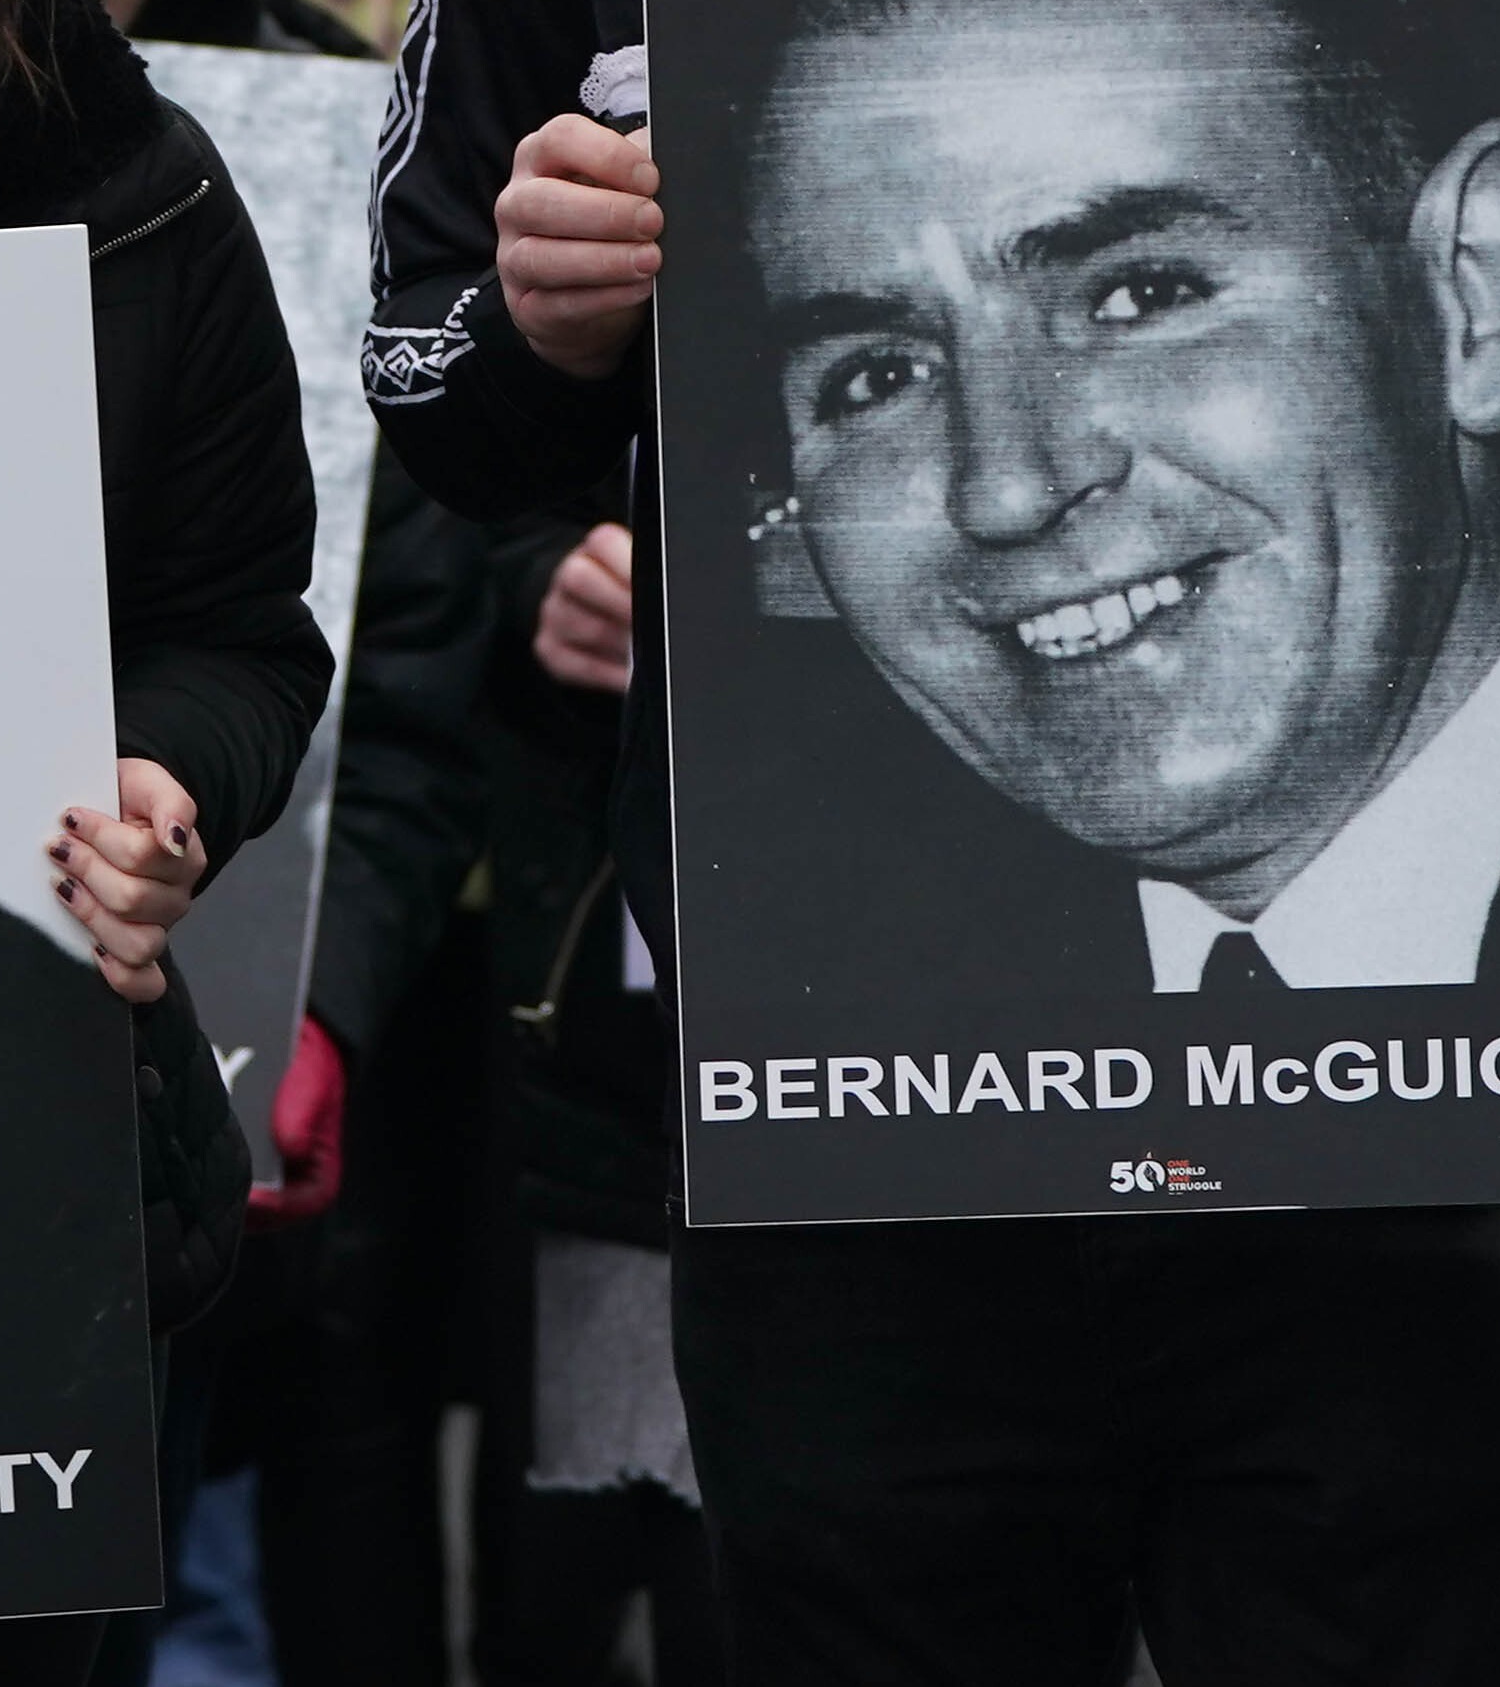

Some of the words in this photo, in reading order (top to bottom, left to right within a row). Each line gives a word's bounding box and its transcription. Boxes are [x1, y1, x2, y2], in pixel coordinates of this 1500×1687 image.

[699, 1048, 1154, 1122] BERNARD
[1167, 1166, 1207, 1176] WORLD
[1167, 1181, 1223, 1192] STRUGGLE
